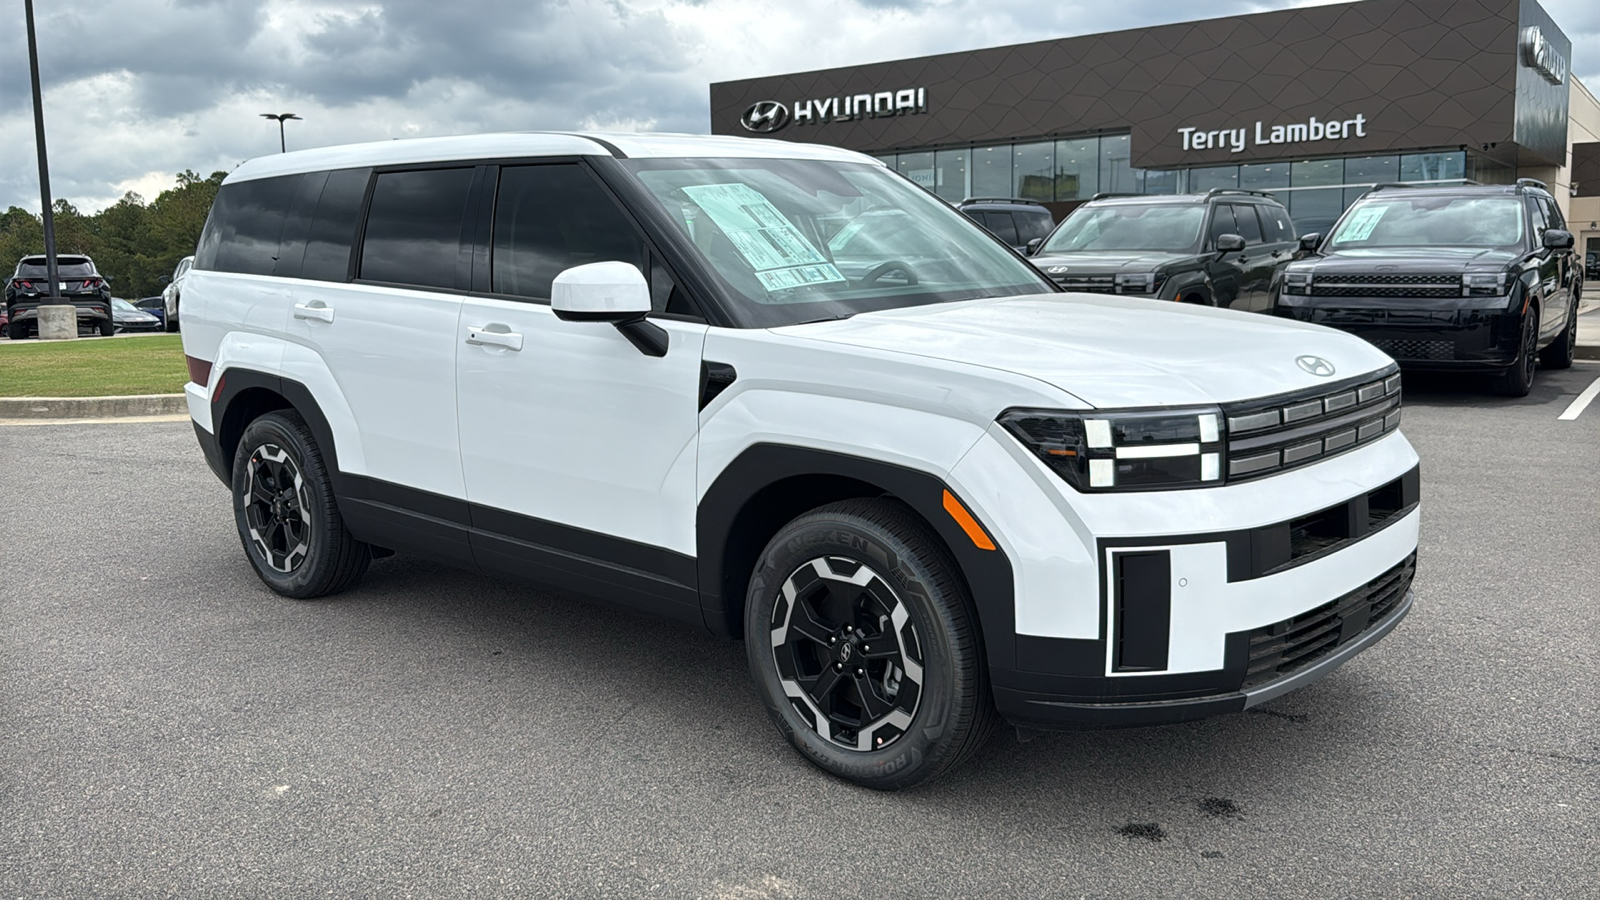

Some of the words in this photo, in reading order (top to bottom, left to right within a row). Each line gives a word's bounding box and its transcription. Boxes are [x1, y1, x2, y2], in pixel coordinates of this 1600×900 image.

[794, 87, 926, 122] HYUNDAI
[1177, 127, 1247, 153] Terry
[1254, 113, 1367, 145] Lambert
[912, 174, 937, 182] IONI
